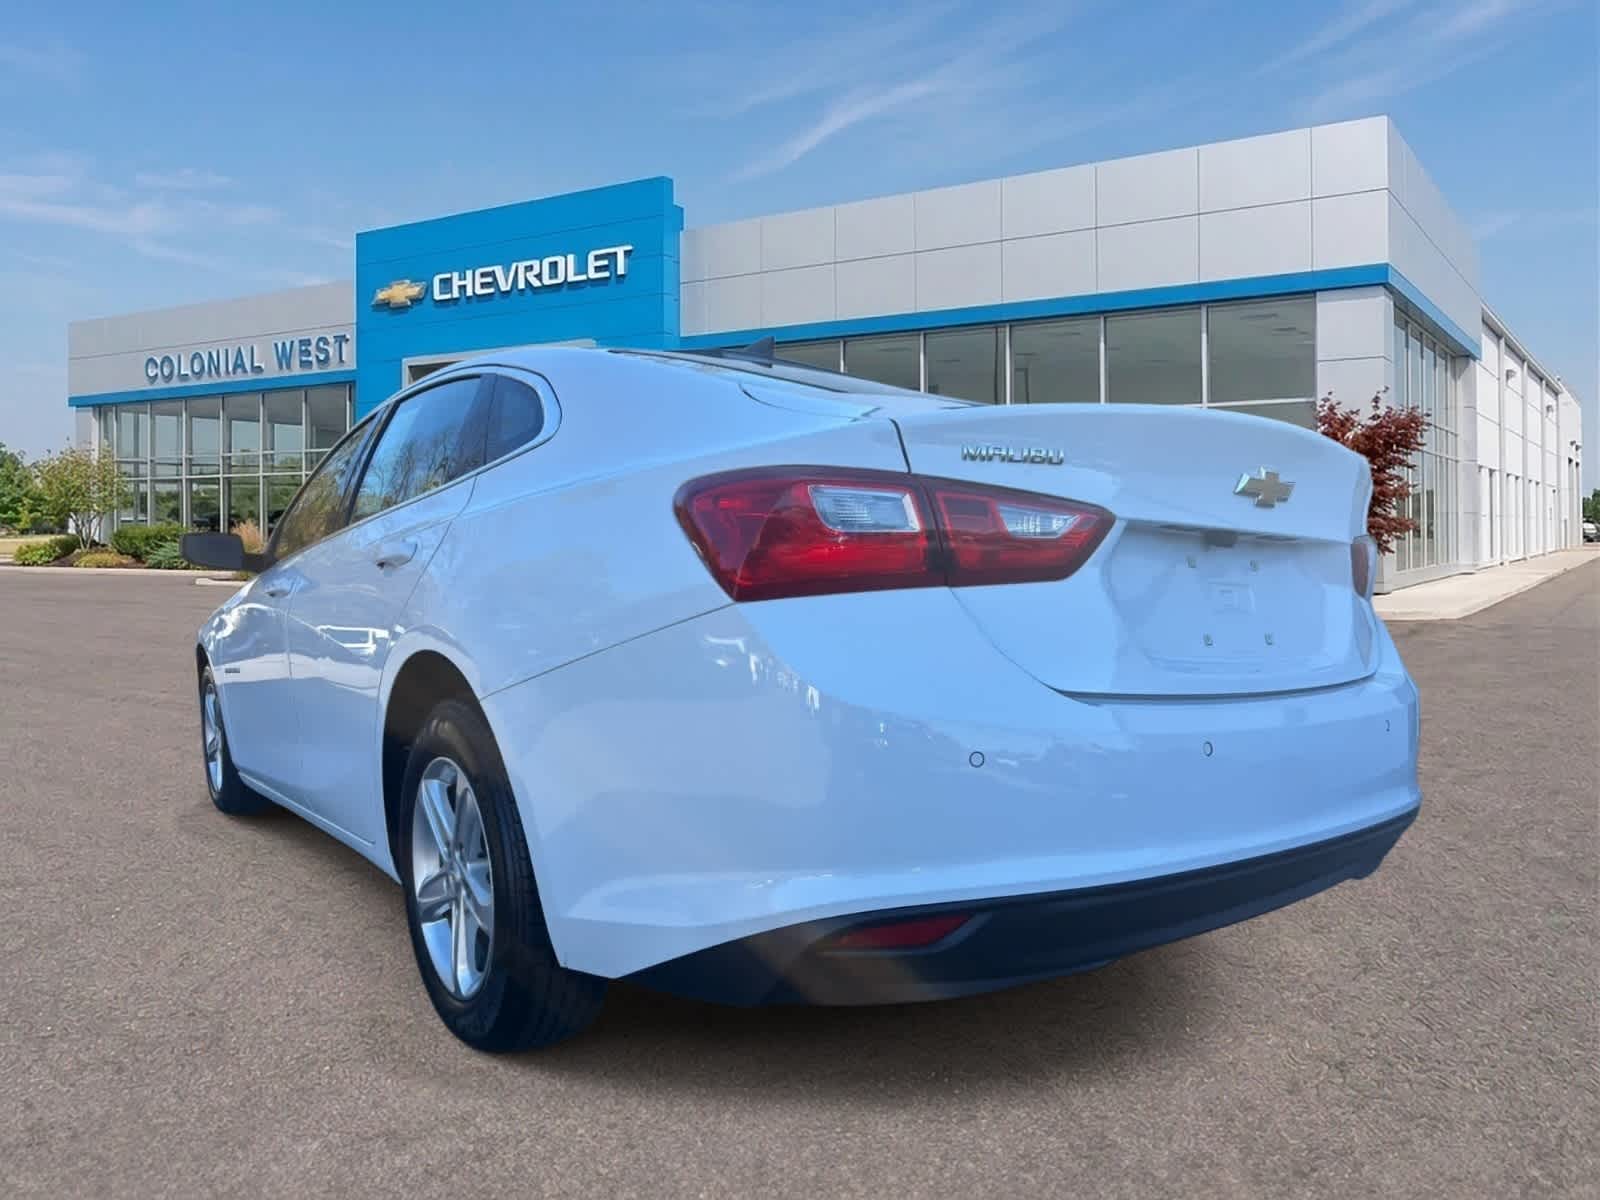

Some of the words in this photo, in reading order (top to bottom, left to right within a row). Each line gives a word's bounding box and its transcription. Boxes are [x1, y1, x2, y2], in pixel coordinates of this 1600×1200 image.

[432, 244, 633, 302] CHEVROLET
[144, 342, 264, 383] COLONIAL
[274, 333, 350, 370] WEST
[961, 444, 1065, 466] MALIBU
